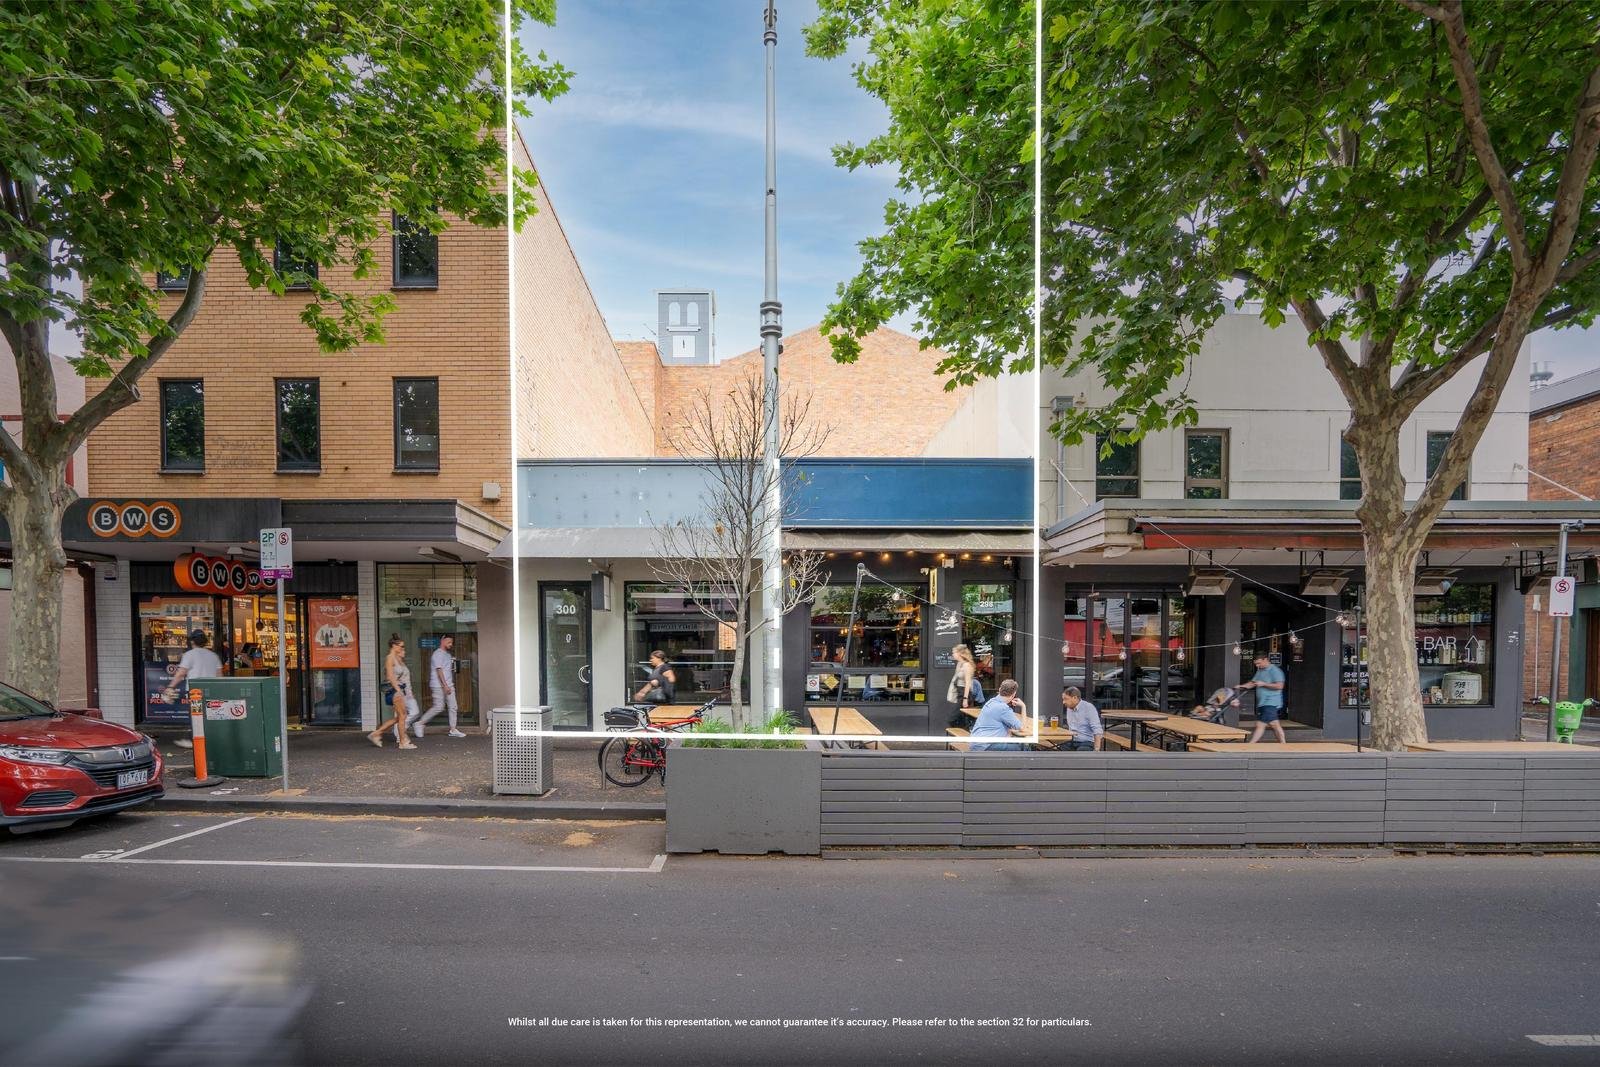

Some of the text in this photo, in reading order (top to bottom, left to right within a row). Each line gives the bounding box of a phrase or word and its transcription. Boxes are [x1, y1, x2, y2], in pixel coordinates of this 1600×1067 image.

[101, 512, 169, 526] BWS
[262, 532, 275, 543] 2P
[197, 566, 243, 586] BWS
[405, 597, 453, 607] 302/304
[556, 604, 576, 615] 300
[1423, 636, 1457, 651] BAR
